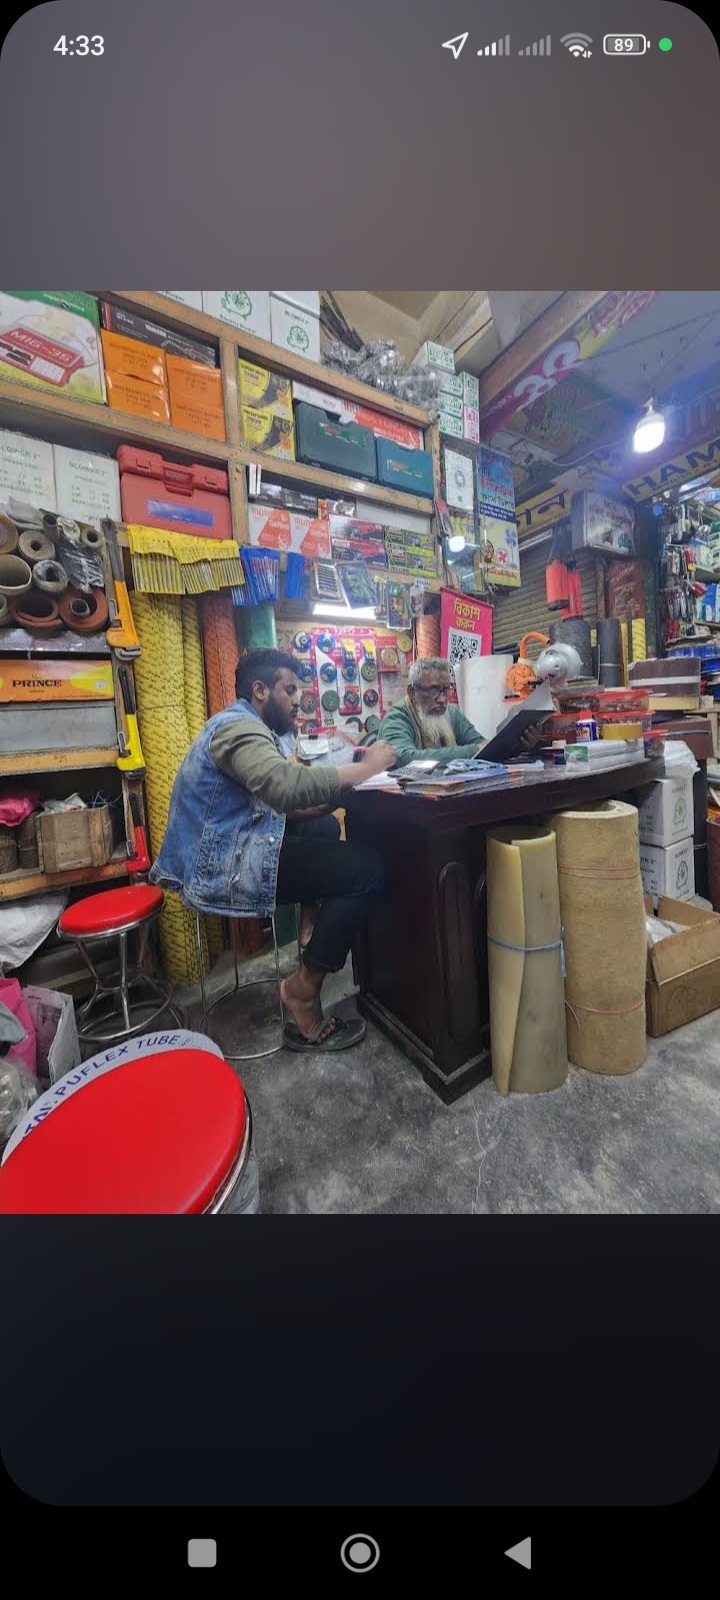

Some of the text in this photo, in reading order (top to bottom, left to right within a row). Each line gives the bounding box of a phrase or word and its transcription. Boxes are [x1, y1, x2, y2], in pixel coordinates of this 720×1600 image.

[12, 679, 62, 688] PRINCE
[54, 1045, 129, 1096] PUFLEX
[137, 1034, 181, 1049] TUBE
